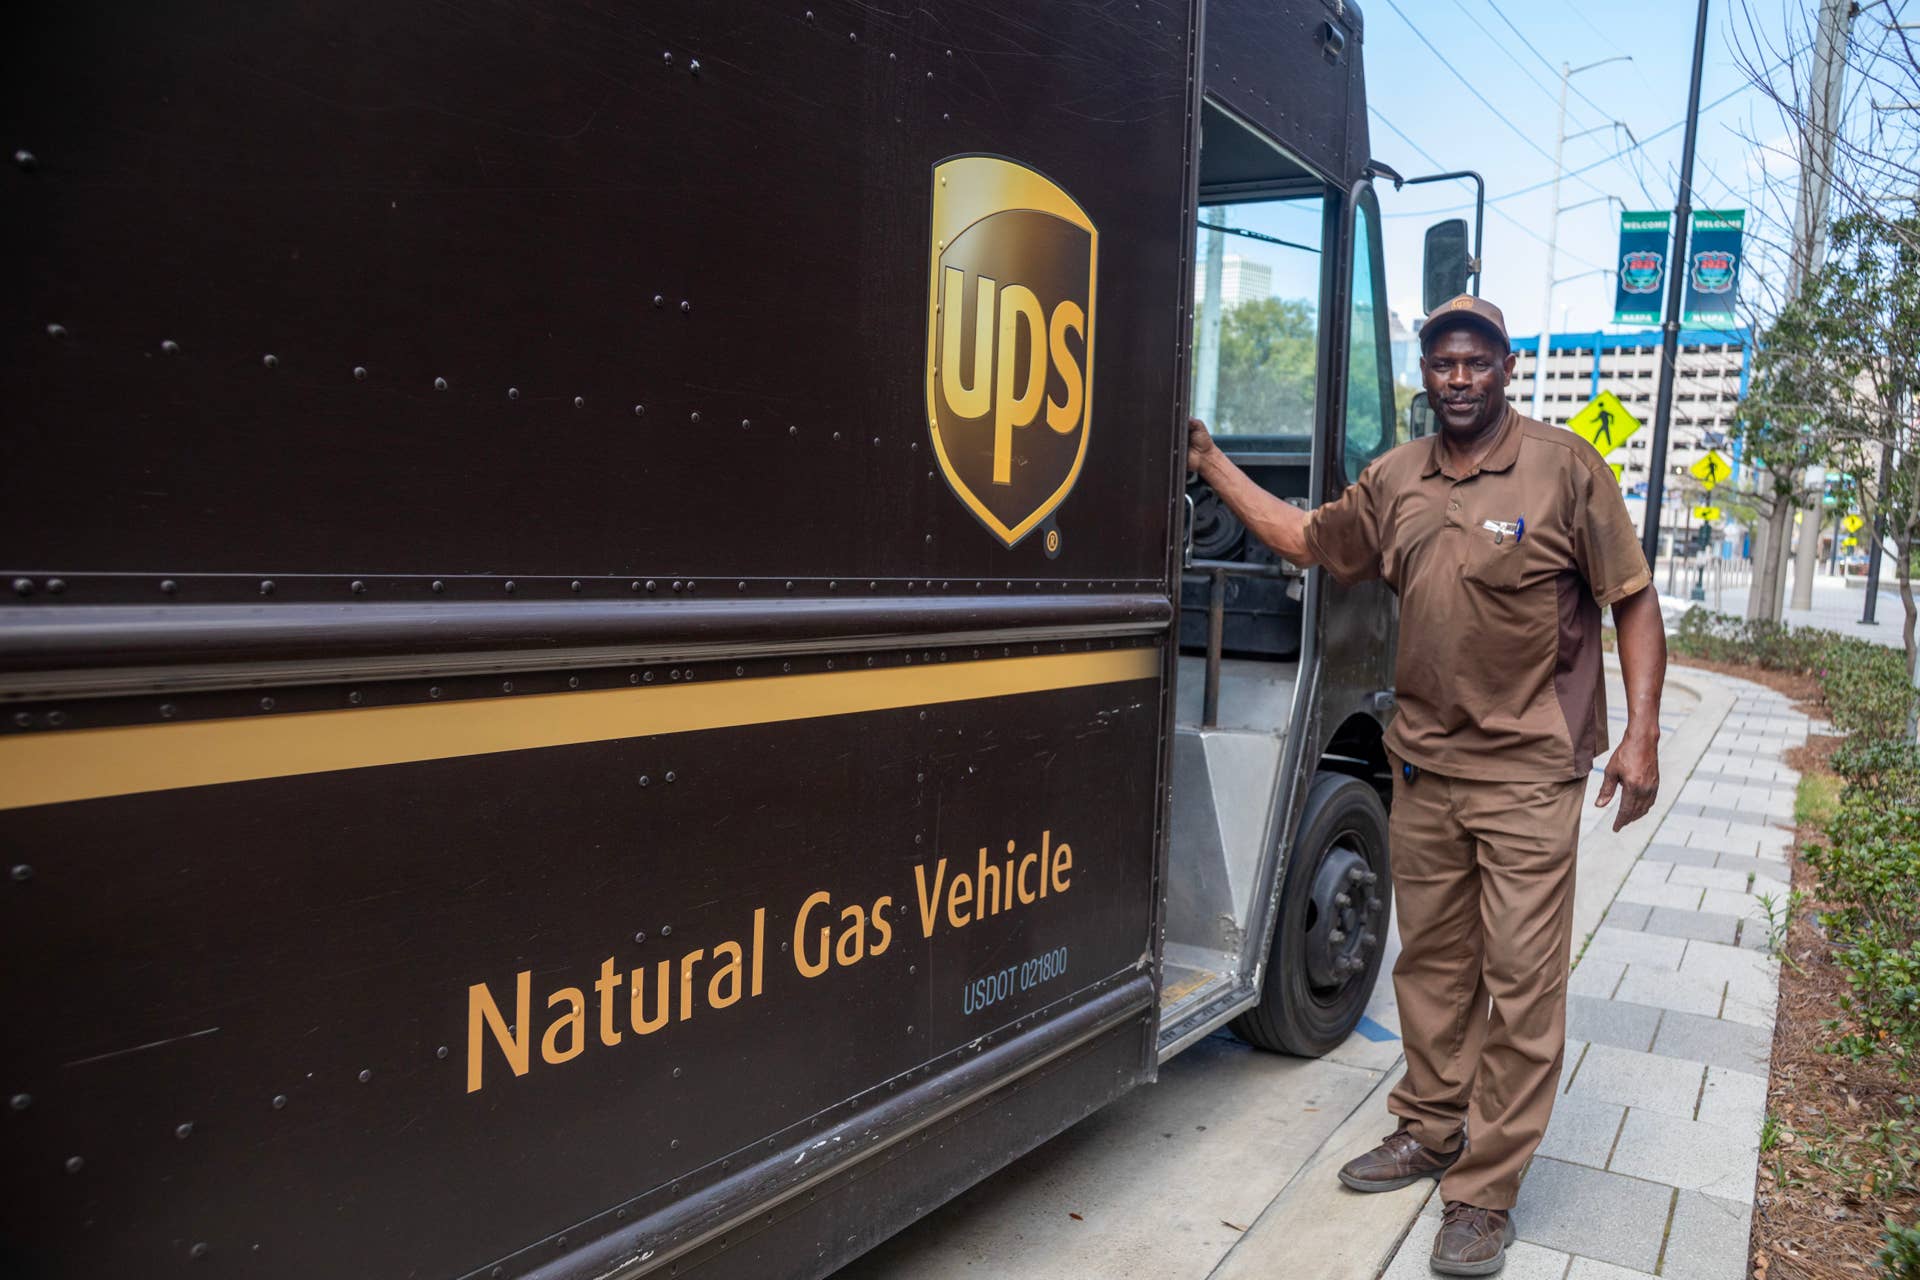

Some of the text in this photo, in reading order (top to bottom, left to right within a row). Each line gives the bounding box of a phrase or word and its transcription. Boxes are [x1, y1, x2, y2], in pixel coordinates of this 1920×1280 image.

[1623, 221, 1668, 230] WELCOME
[1695, 220, 1742, 229] WELCOME
[941, 266, 1085, 485] ups
[466, 830, 1073, 1093] Natural Gas Vehicle
[964, 946, 1067, 1015] USDOT 021800
